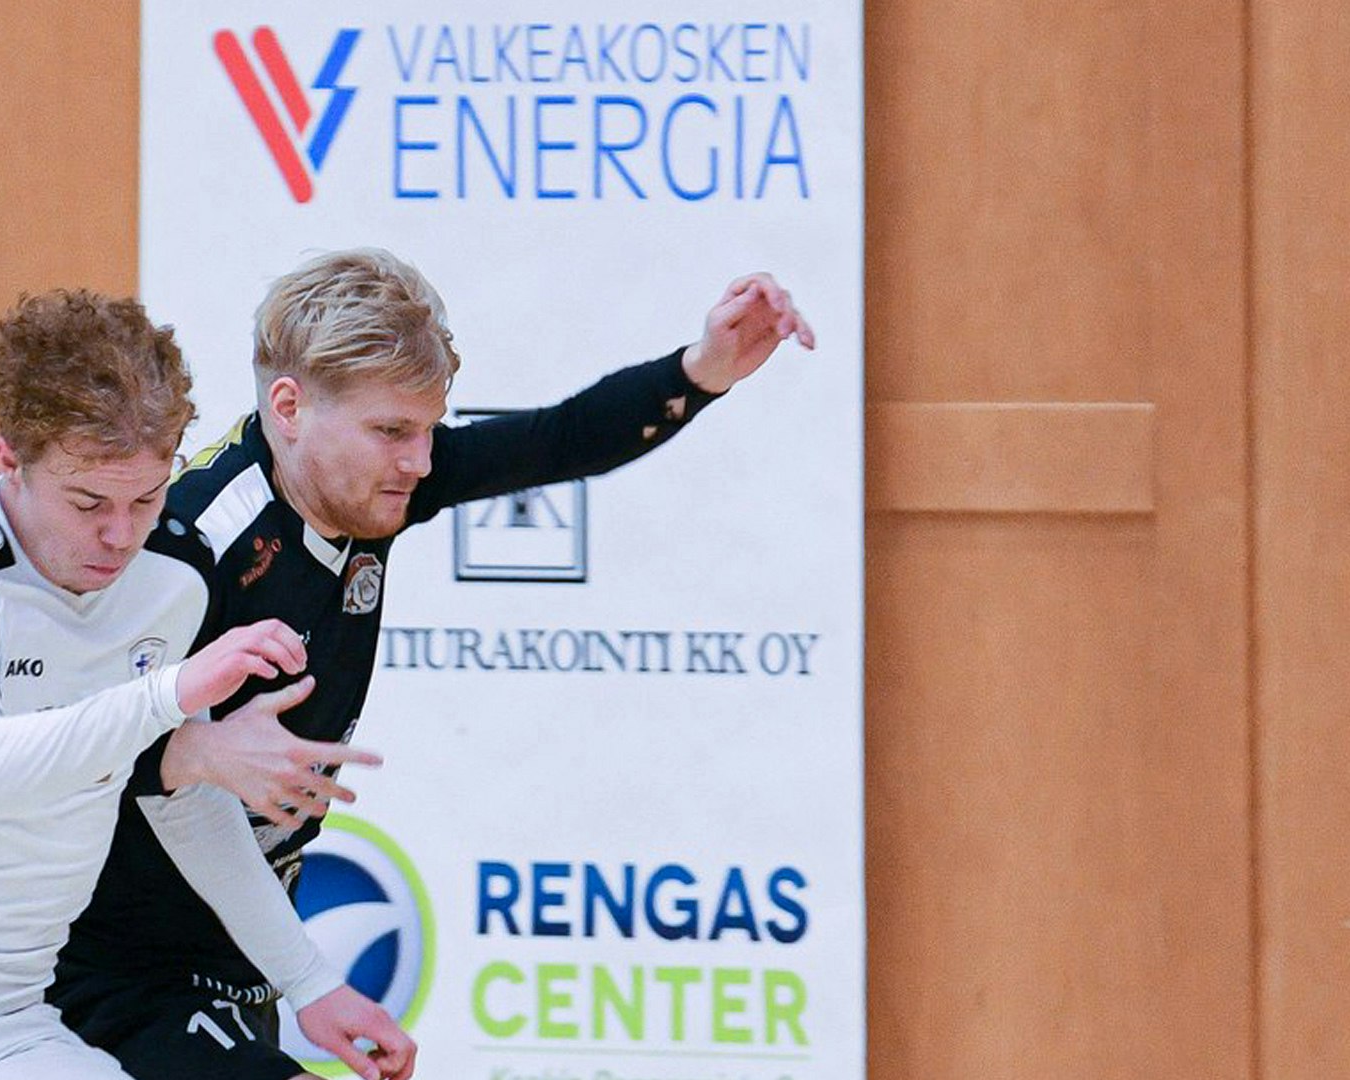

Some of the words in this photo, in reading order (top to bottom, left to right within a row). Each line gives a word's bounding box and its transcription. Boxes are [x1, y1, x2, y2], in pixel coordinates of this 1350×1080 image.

[386, 23, 810, 83] VALKEAKOSKEN
[392, 93, 811, 203] ENERGIA
[683, 632, 748, 674] KK
[757, 632, 821, 677] OY
[476, 861, 810, 945] RENGAS
[471, 960, 810, 1046] CENTER
